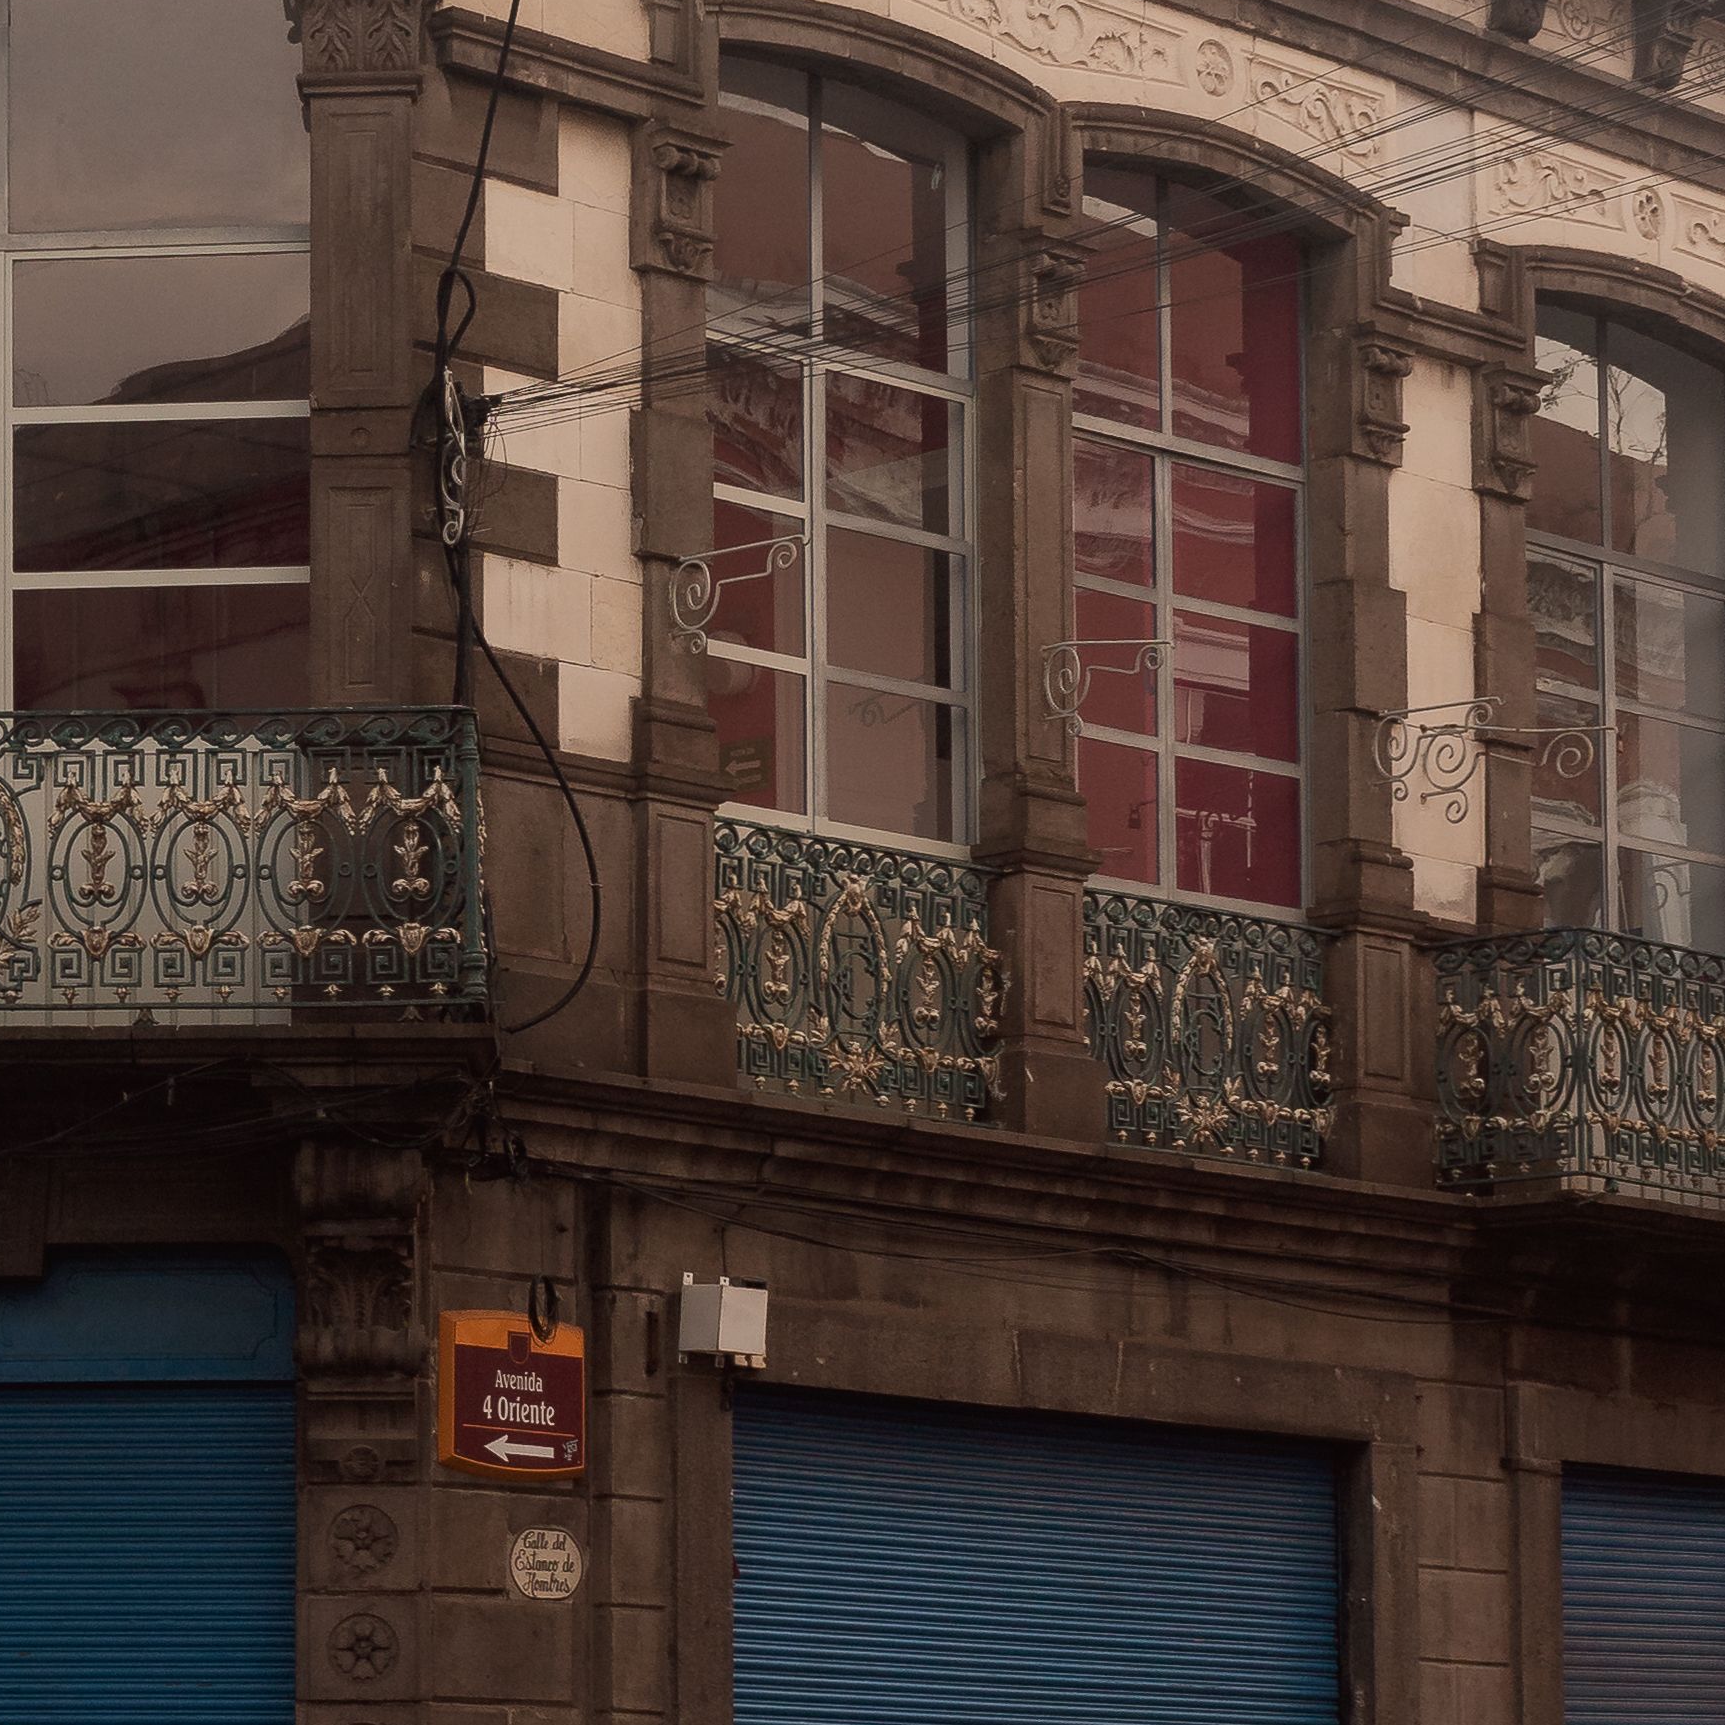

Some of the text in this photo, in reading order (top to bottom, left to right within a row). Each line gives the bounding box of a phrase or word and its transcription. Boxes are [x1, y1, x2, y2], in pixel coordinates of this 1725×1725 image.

[495, 1369, 543, 1393] Avenida
[482, 1394, 556, 1427] 4 Oriente
[521, 1531, 567, 1551] Calle del
[515, 1549, 576, 1574] Estanco de
[522, 1571, 571, 1597] Hombres
